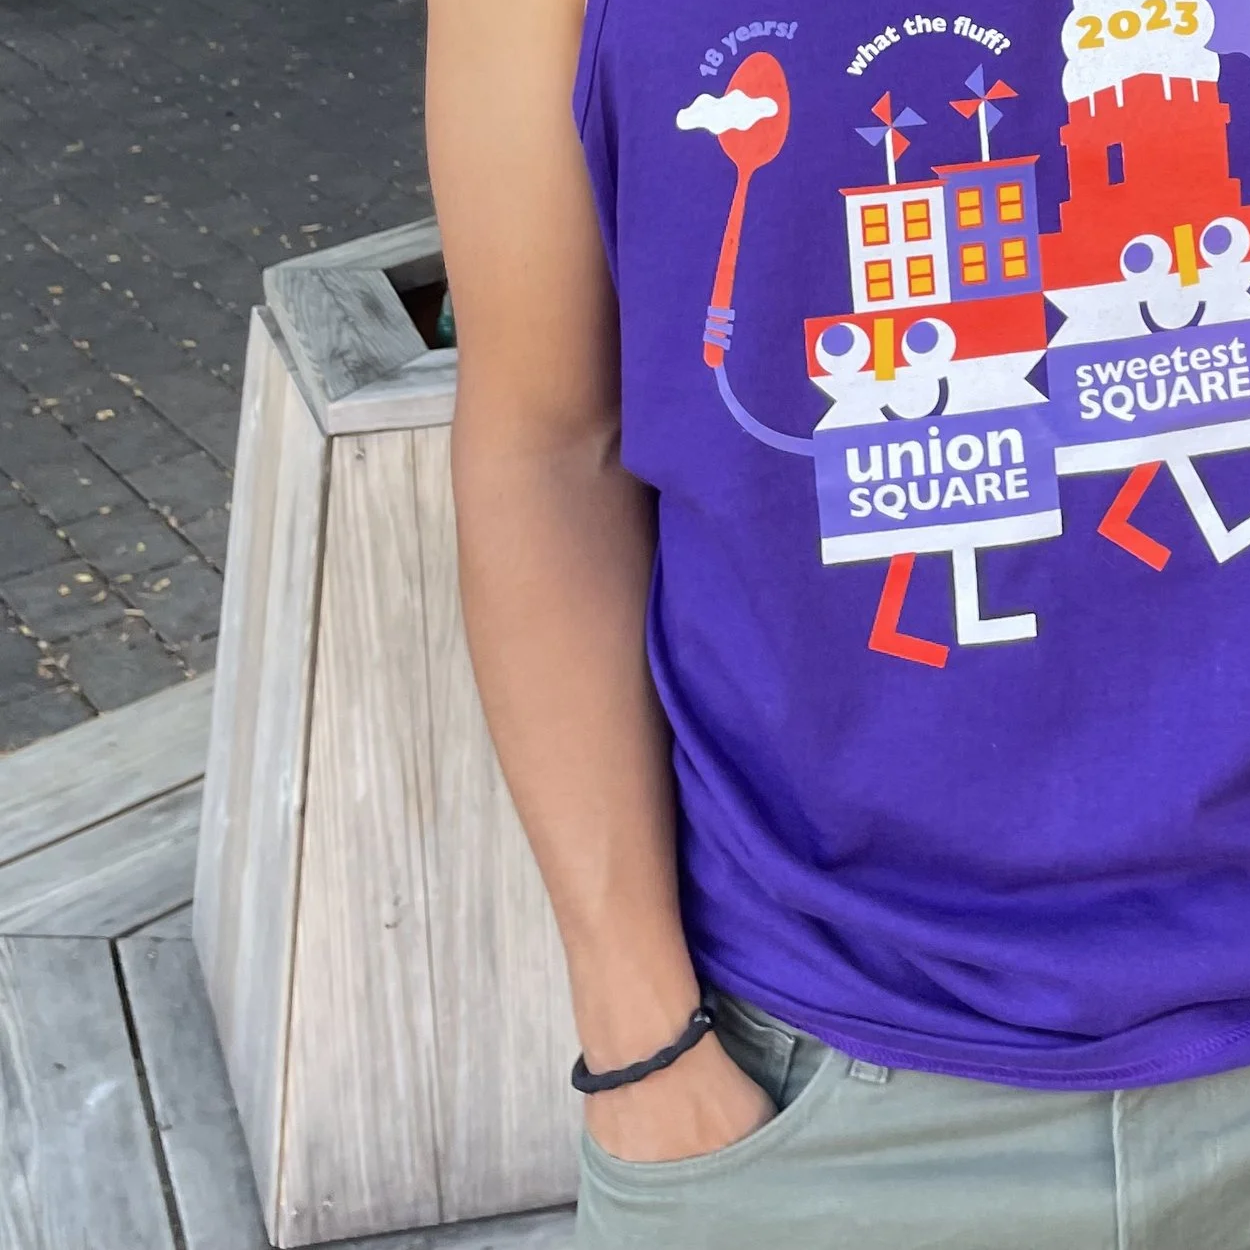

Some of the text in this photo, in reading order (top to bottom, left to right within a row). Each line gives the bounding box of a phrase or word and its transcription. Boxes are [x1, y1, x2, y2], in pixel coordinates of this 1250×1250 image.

[699, 20, 799, 78] 18 years!
[846, 14, 1012, 77] what the fluff?
[1075, 336, 1248, 388] sweetest
[845, 425, 1025, 483] union
[848, 467, 1030, 520] SQUARE
